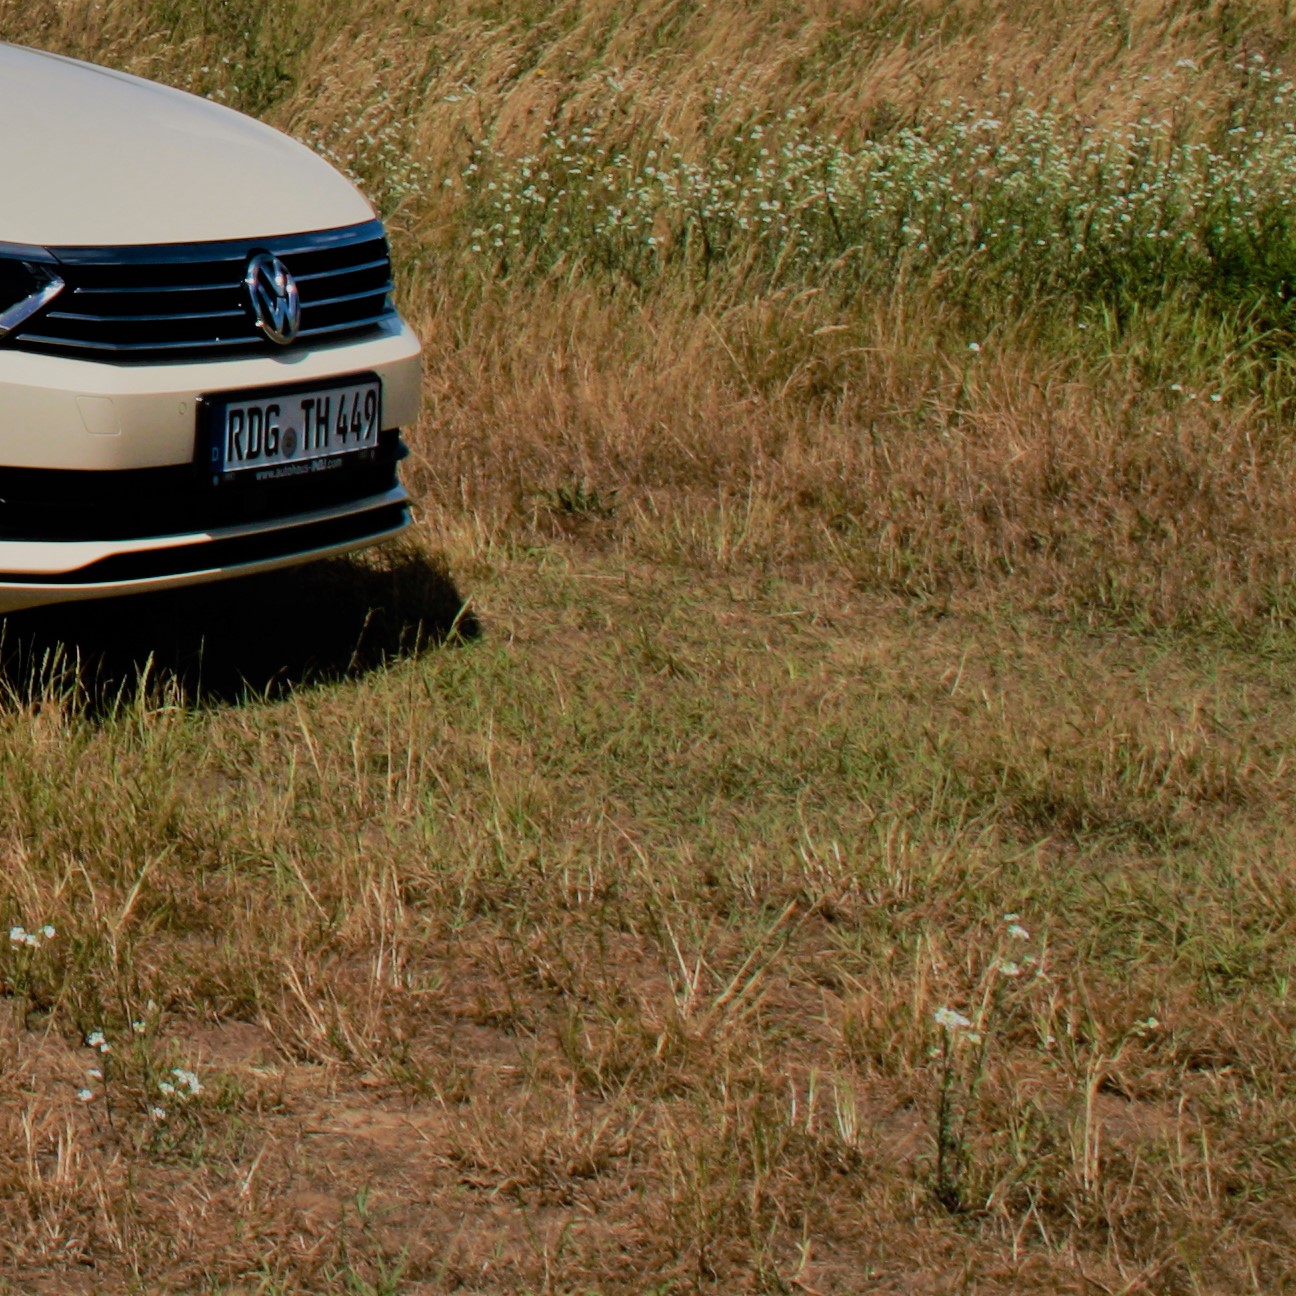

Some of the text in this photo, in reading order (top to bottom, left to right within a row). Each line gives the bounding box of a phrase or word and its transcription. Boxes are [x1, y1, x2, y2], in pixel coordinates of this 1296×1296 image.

[226, 389, 378, 462] RDG TH 449
